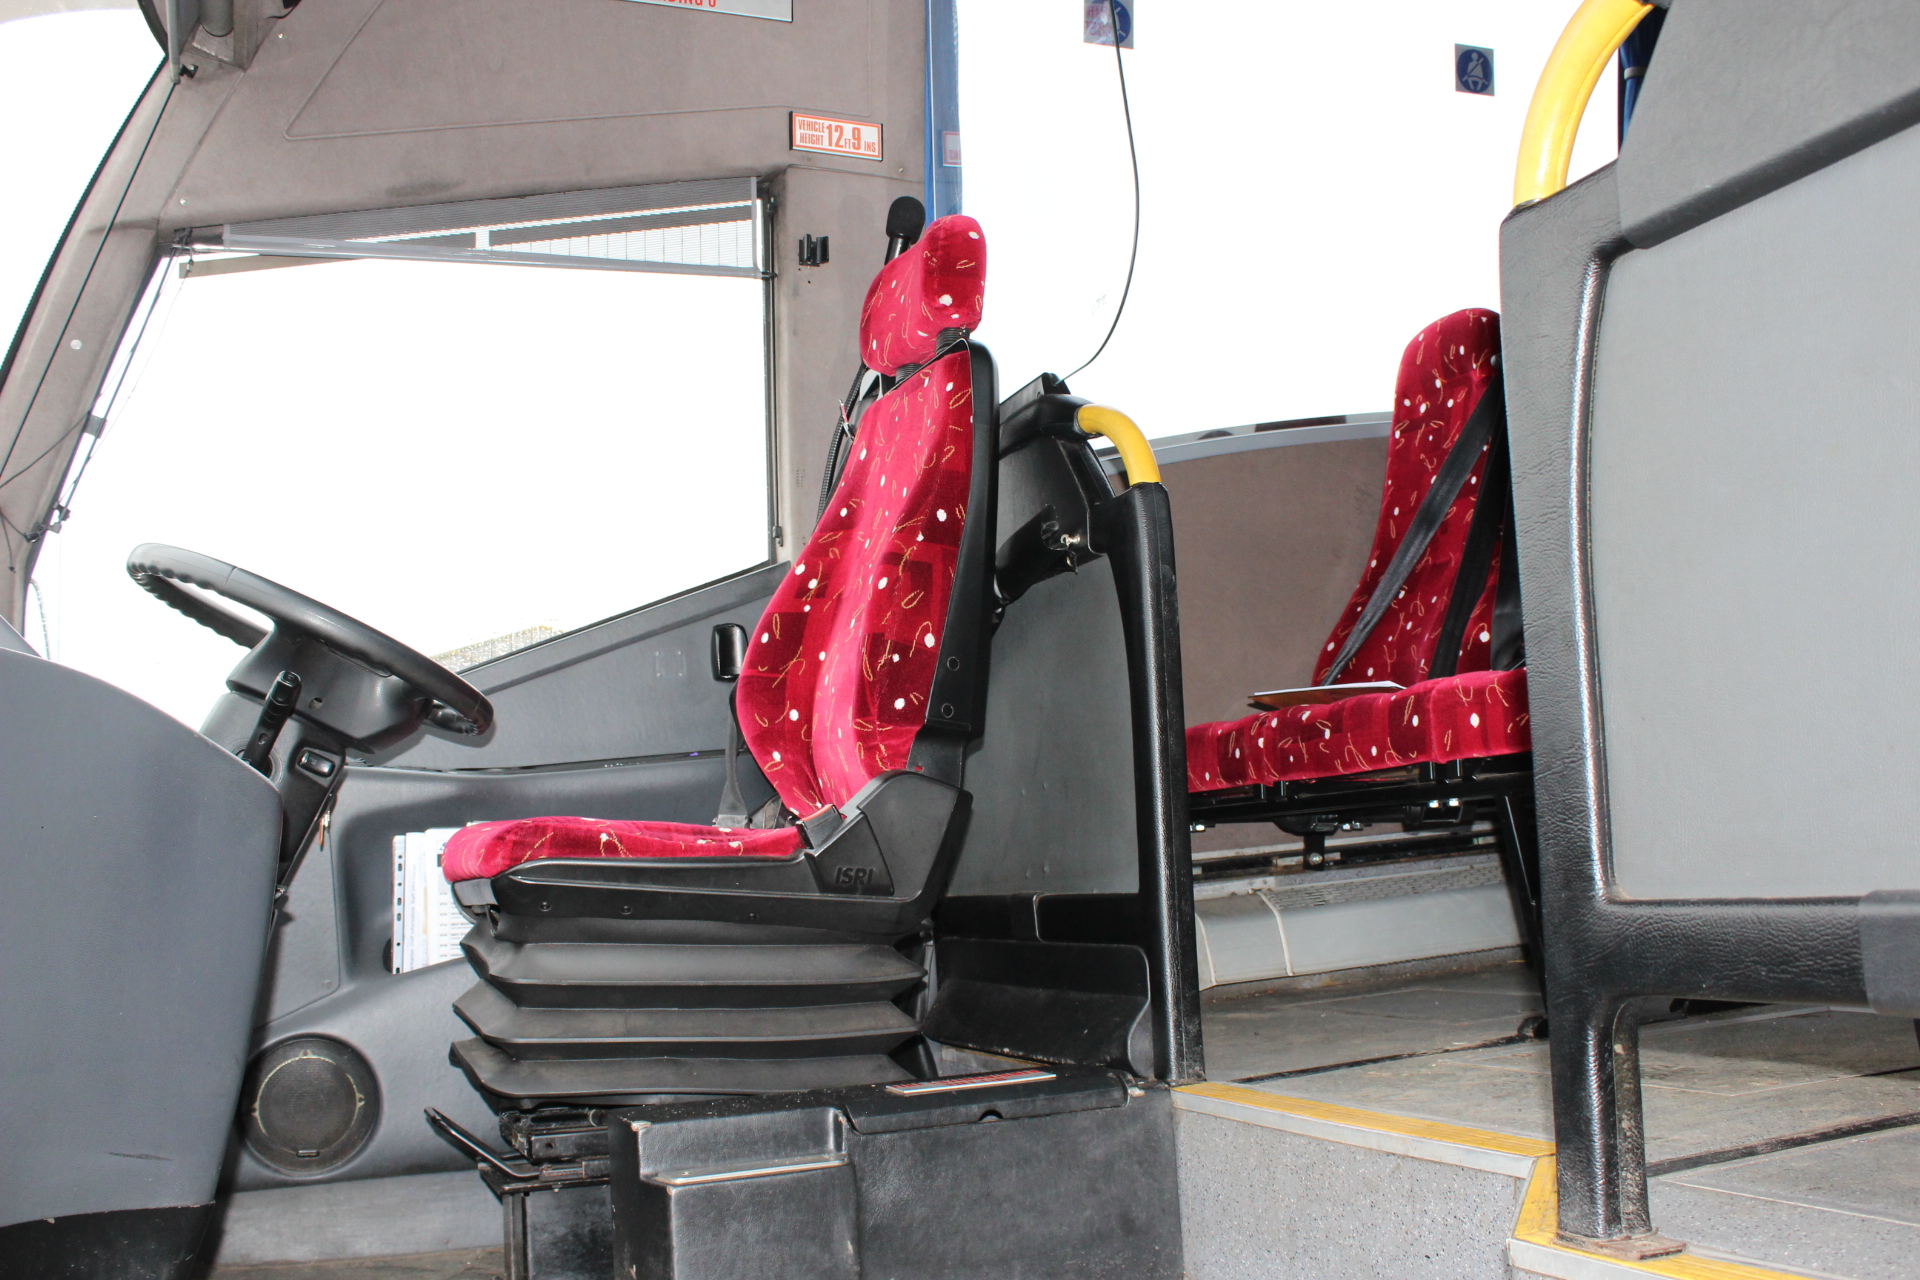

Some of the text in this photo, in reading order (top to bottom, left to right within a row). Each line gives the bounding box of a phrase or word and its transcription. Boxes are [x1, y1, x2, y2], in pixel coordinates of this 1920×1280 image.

[797, 118, 826, 133] VEHICLE
[799, 132, 824, 146] HEIGHT
[826, 123, 876, 153] 12 FT 9 INS
[835, 867, 873, 885] ISRI
